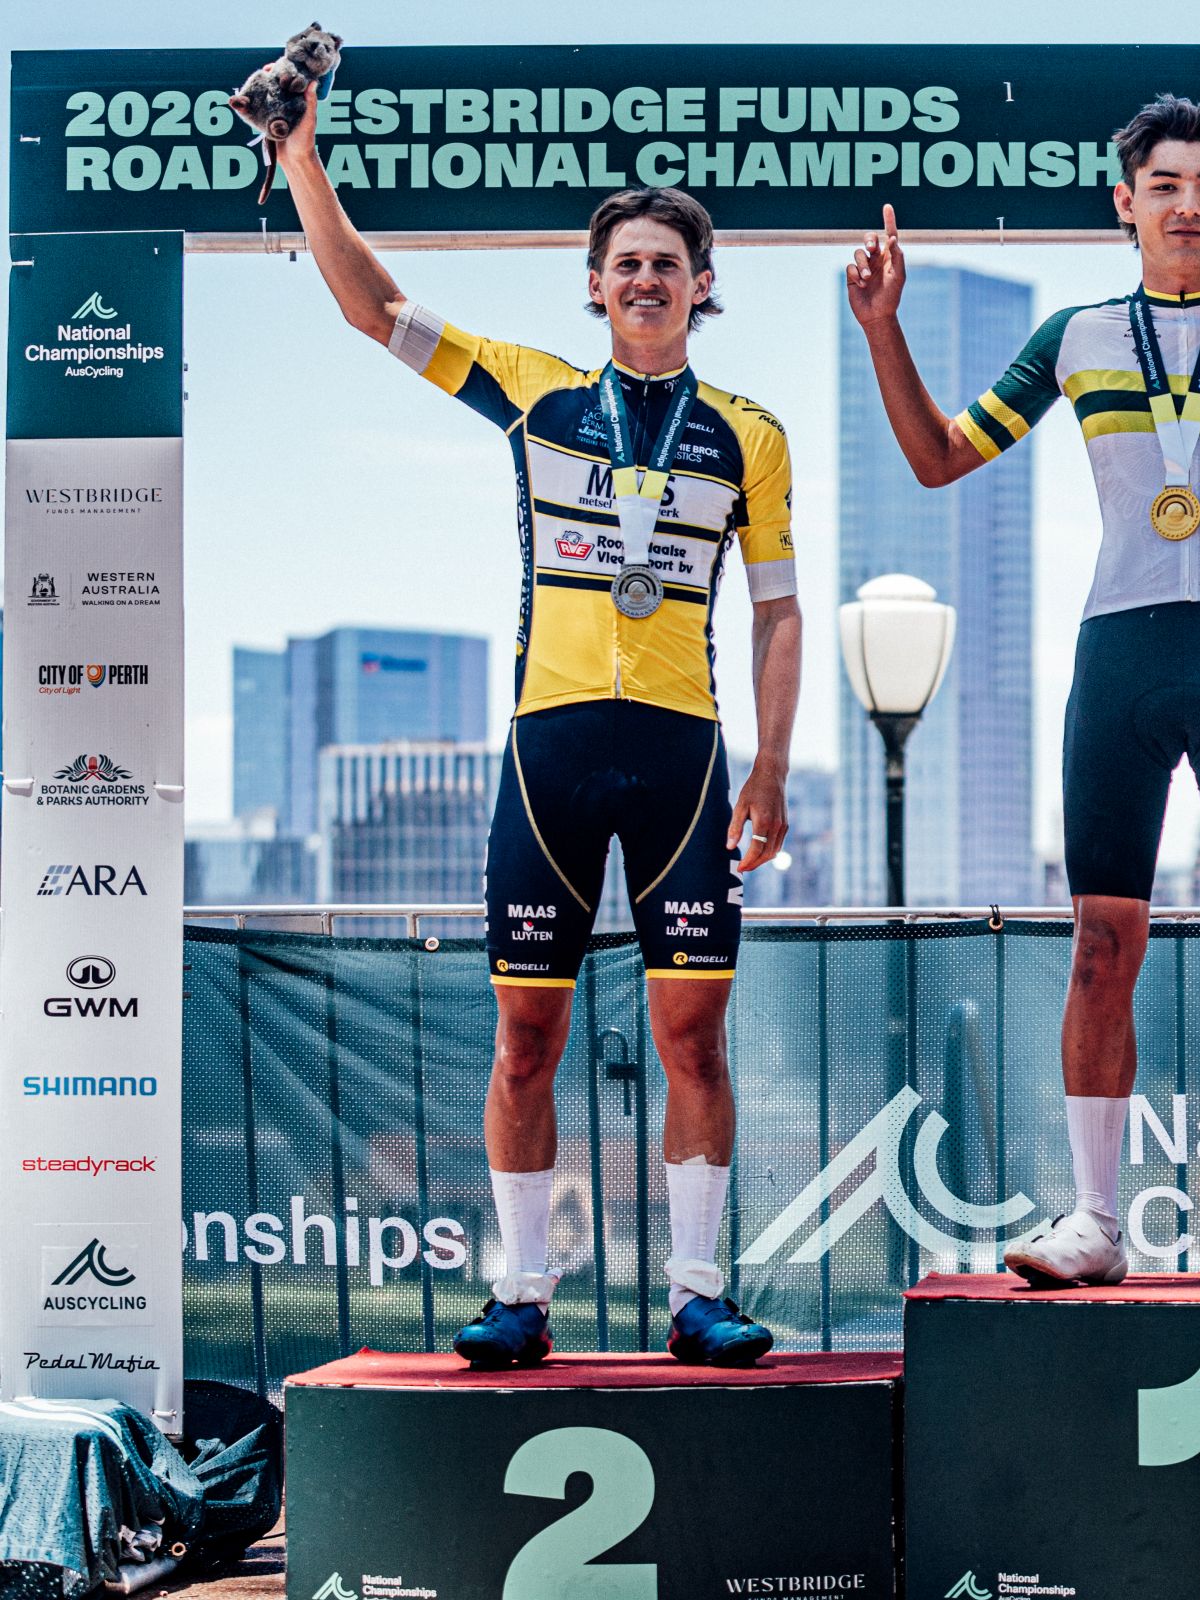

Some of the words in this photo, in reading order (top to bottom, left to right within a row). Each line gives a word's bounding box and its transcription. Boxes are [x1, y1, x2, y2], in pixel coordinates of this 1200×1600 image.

[64, 91, 234, 137] 2026
[251, 88, 706, 135] ESTBRIDGE
[720, 87, 959, 133] FUNDS
[65, 145, 258, 190] ROAD
[58, 324, 131, 341] National
[25, 343, 164, 364] Championships
[64, 366, 124, 378] AusCycling
[1144, 351, 1158, 380] National
[674, 395, 689, 419] National
[612, 423, 623, 452] National
[657, 418, 681, 467] Championships
[26, 488, 163, 503] WESTBRIDGE
[579, 496, 613, 509] metsel
[679, 560, 694, 574] bv
[87, 572, 155, 582] WESTERN
[81, 585, 160, 595] AUSTRALIA
[38, 665, 66, 685] CITY
[68, 665, 84, 685] OF
[109, 665, 148, 685] PERTH
[38, 687, 53, 695] City
[62, 687, 81, 695] Light
[41, 785, 90, 794] BOTANIC
[91, 785, 145, 794] GARDENS
[36, 796, 44, 805] &
[46, 796, 83, 805] PARKS
[84, 796, 149, 805] AUTHORITY
[65, 865, 148, 896] ARA
[508, 904, 557, 918] MAAS
[664, 901, 714, 915] MAAS
[512, 930, 553, 941] LUYTEN
[666, 926, 708, 937] LUYTEN
[688, 955, 728, 963] ROGELLI
[509, 962, 550, 971] ROGELLI
[44, 997, 138, 1017] GWM
[23, 1077, 157, 1096] SHIMANO
[22, 1156, 156, 1177] steadyrack
[43, 1296, 147, 1310] AUSCYCLING
[24, 1352, 87, 1369] Pedal
[88, 1352, 160, 1373] Mafia
[503, 1426, 657, 1600] 2
[362, 1575, 401, 1585] National
[726, 1574, 866, 1593] WESTBRIDGE
[998, 1573, 1039, 1583] National
[362, 1585, 437, 1599] Championships
[998, 1583, 1076, 1597] Championships
